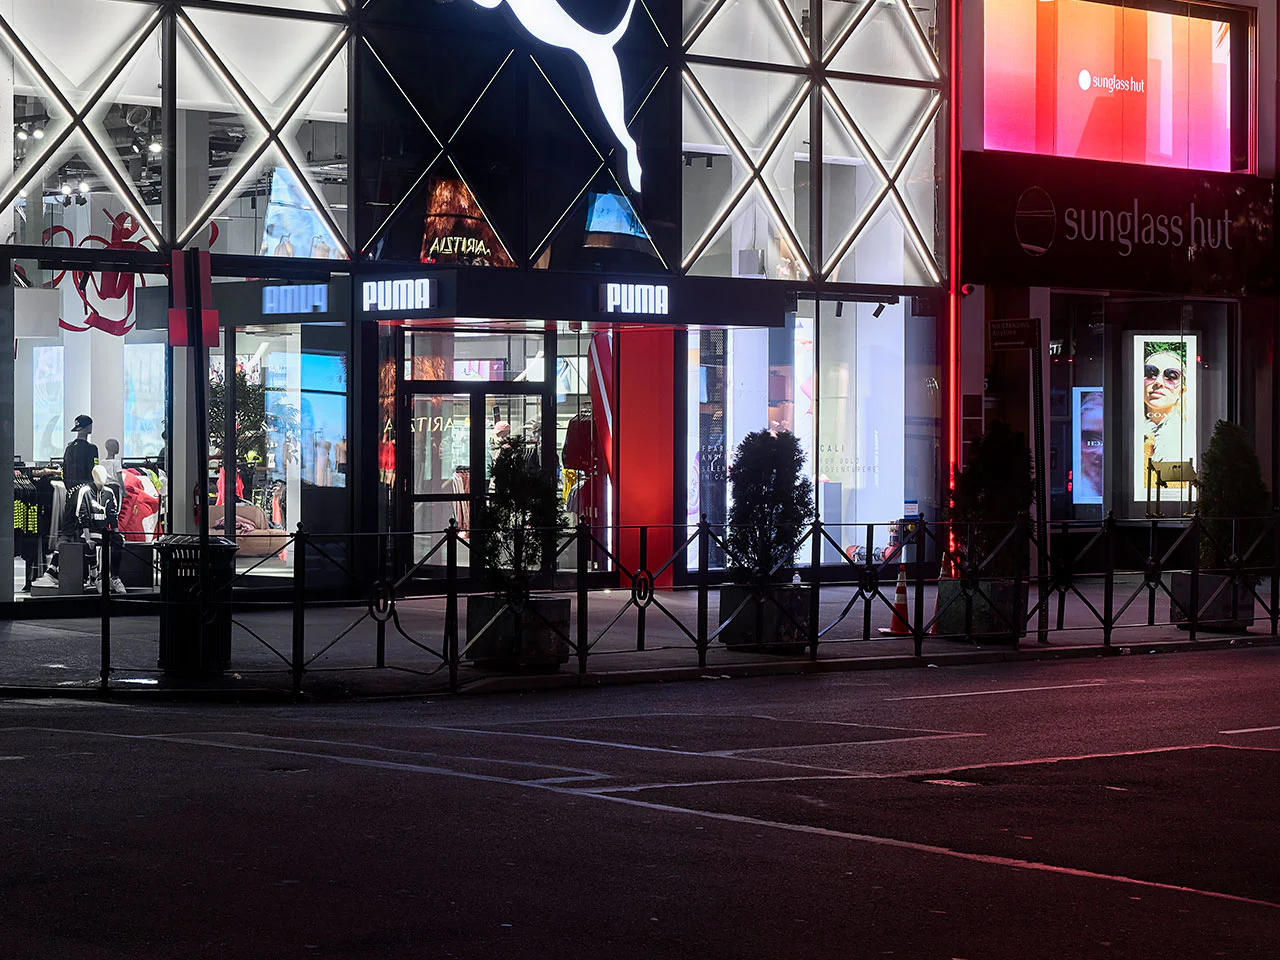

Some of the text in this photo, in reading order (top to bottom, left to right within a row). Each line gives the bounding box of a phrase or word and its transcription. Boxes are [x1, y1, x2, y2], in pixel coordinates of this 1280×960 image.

[1093, 74, 1145, 93] sunglass hut
[1064, 198, 1233, 256] sunglass hut
[362, 278, 430, 312] PUMA
[607, 283, 669, 315] PUMA
[820, 444, 844, 452] CALI
